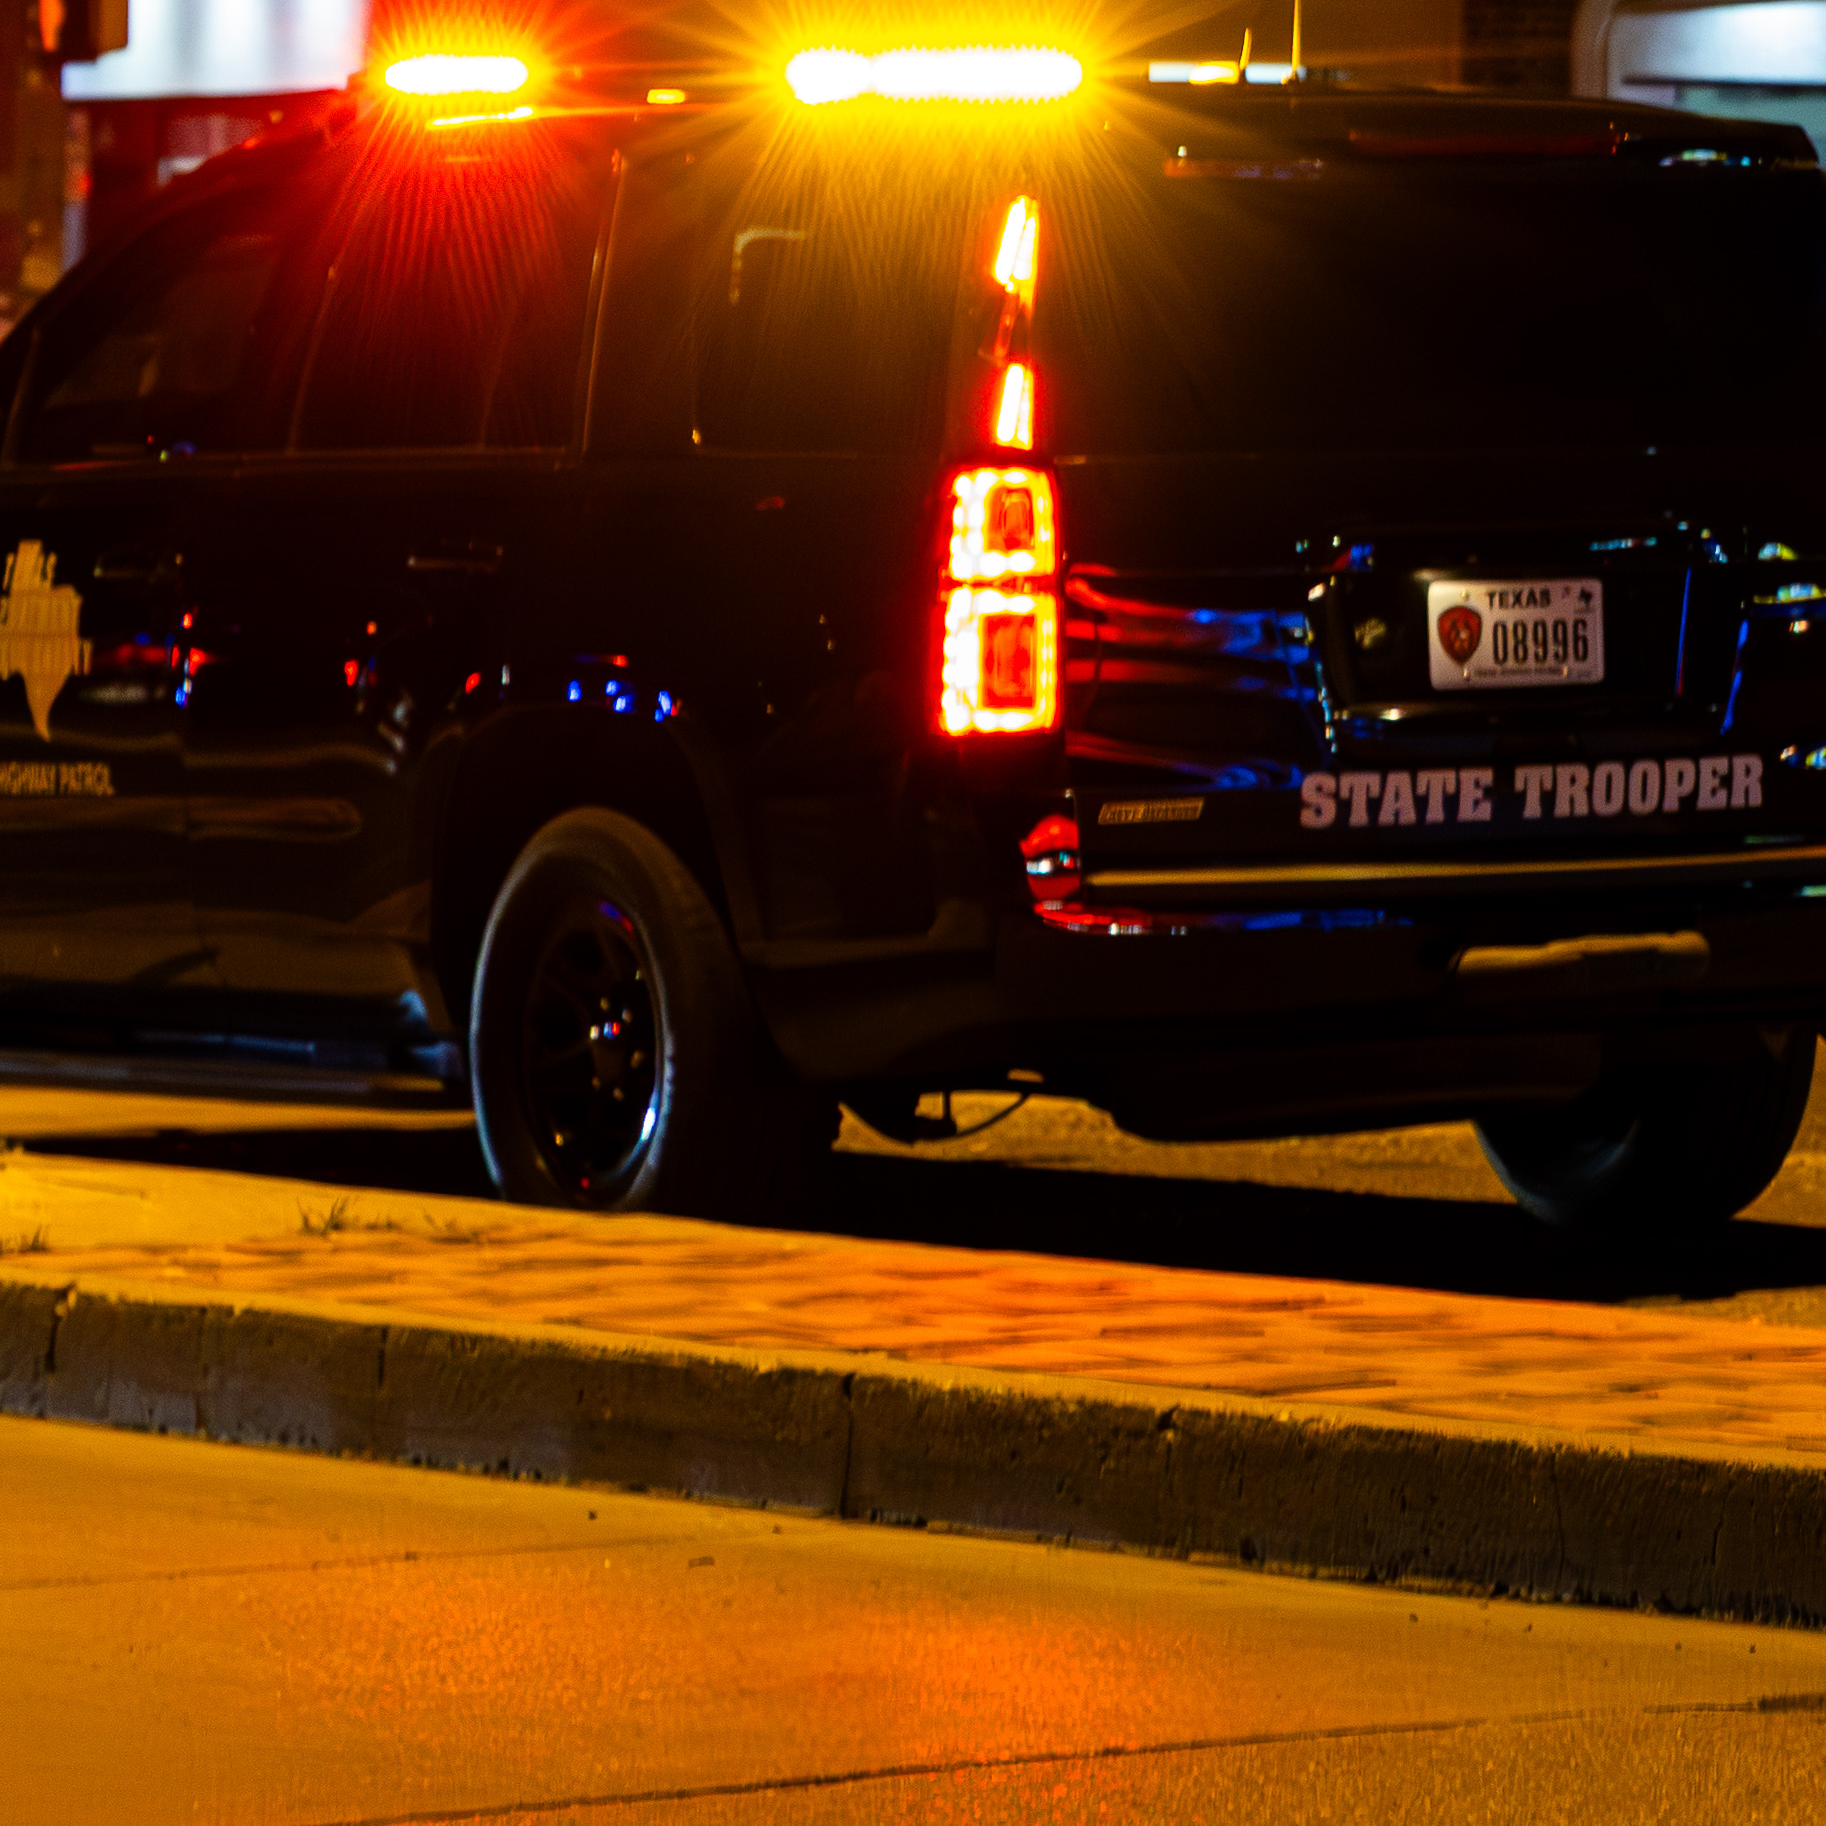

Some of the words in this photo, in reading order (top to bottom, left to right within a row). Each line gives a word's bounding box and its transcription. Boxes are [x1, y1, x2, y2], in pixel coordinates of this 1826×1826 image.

[1487, 587, 1551, 610] TEXAS
[1492, 618, 1589, 665] 08996
[1300, 768, 1494, 829] STATE
[1514, 753, 1763, 819] TROOPER
